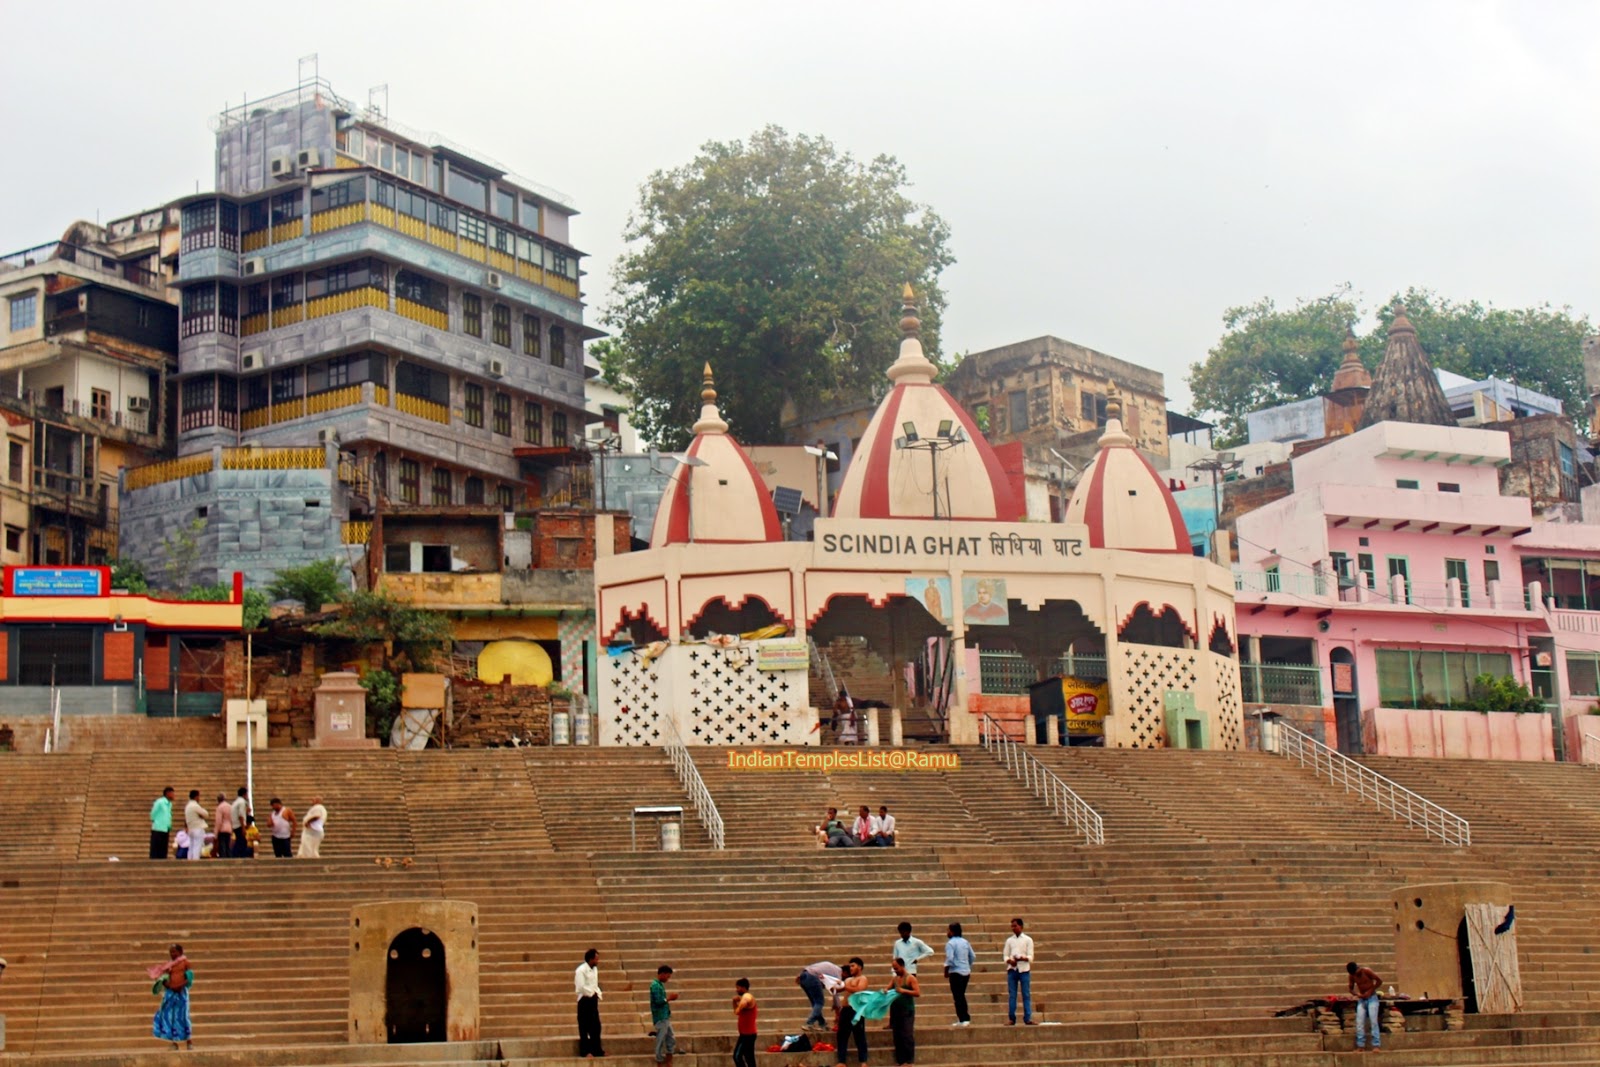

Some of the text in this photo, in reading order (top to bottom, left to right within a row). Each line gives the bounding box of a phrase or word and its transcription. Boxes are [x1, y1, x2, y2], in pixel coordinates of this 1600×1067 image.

[823, 533, 982, 556] SCINDIA GHAT
[1052, 538, 1082, 557] घाट
